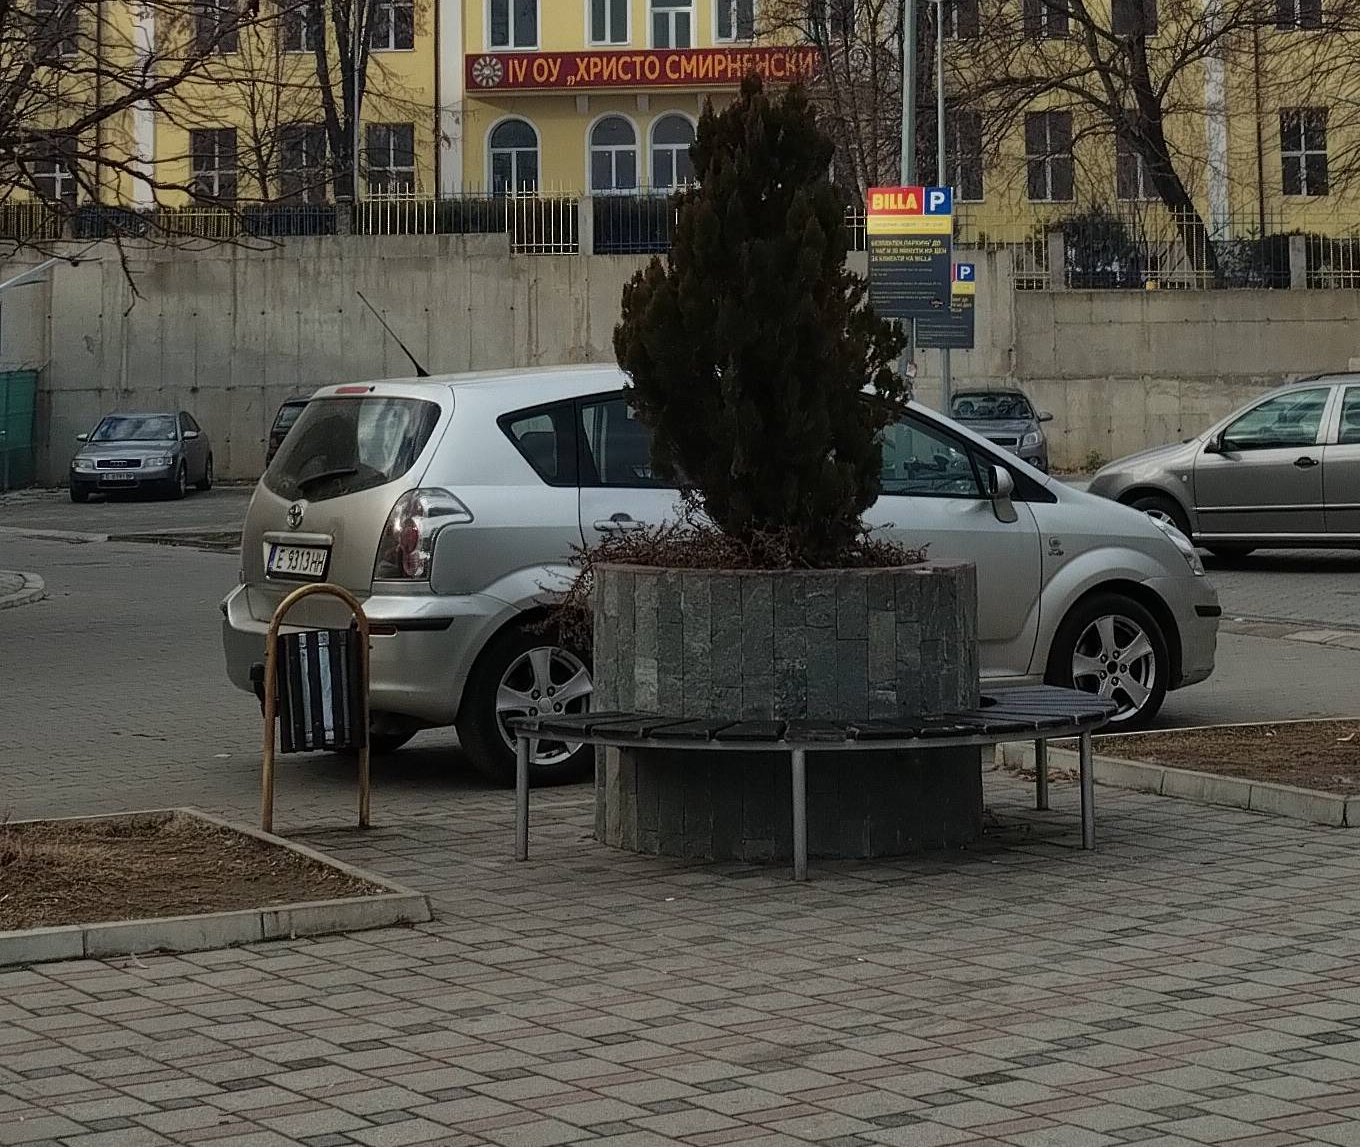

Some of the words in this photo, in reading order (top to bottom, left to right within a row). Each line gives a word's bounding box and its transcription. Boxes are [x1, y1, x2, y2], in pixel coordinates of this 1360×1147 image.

[508, 59, 529, 84] IV
[532, 57, 562, 83] ОУ
[872, 193, 918, 210] BILLA
